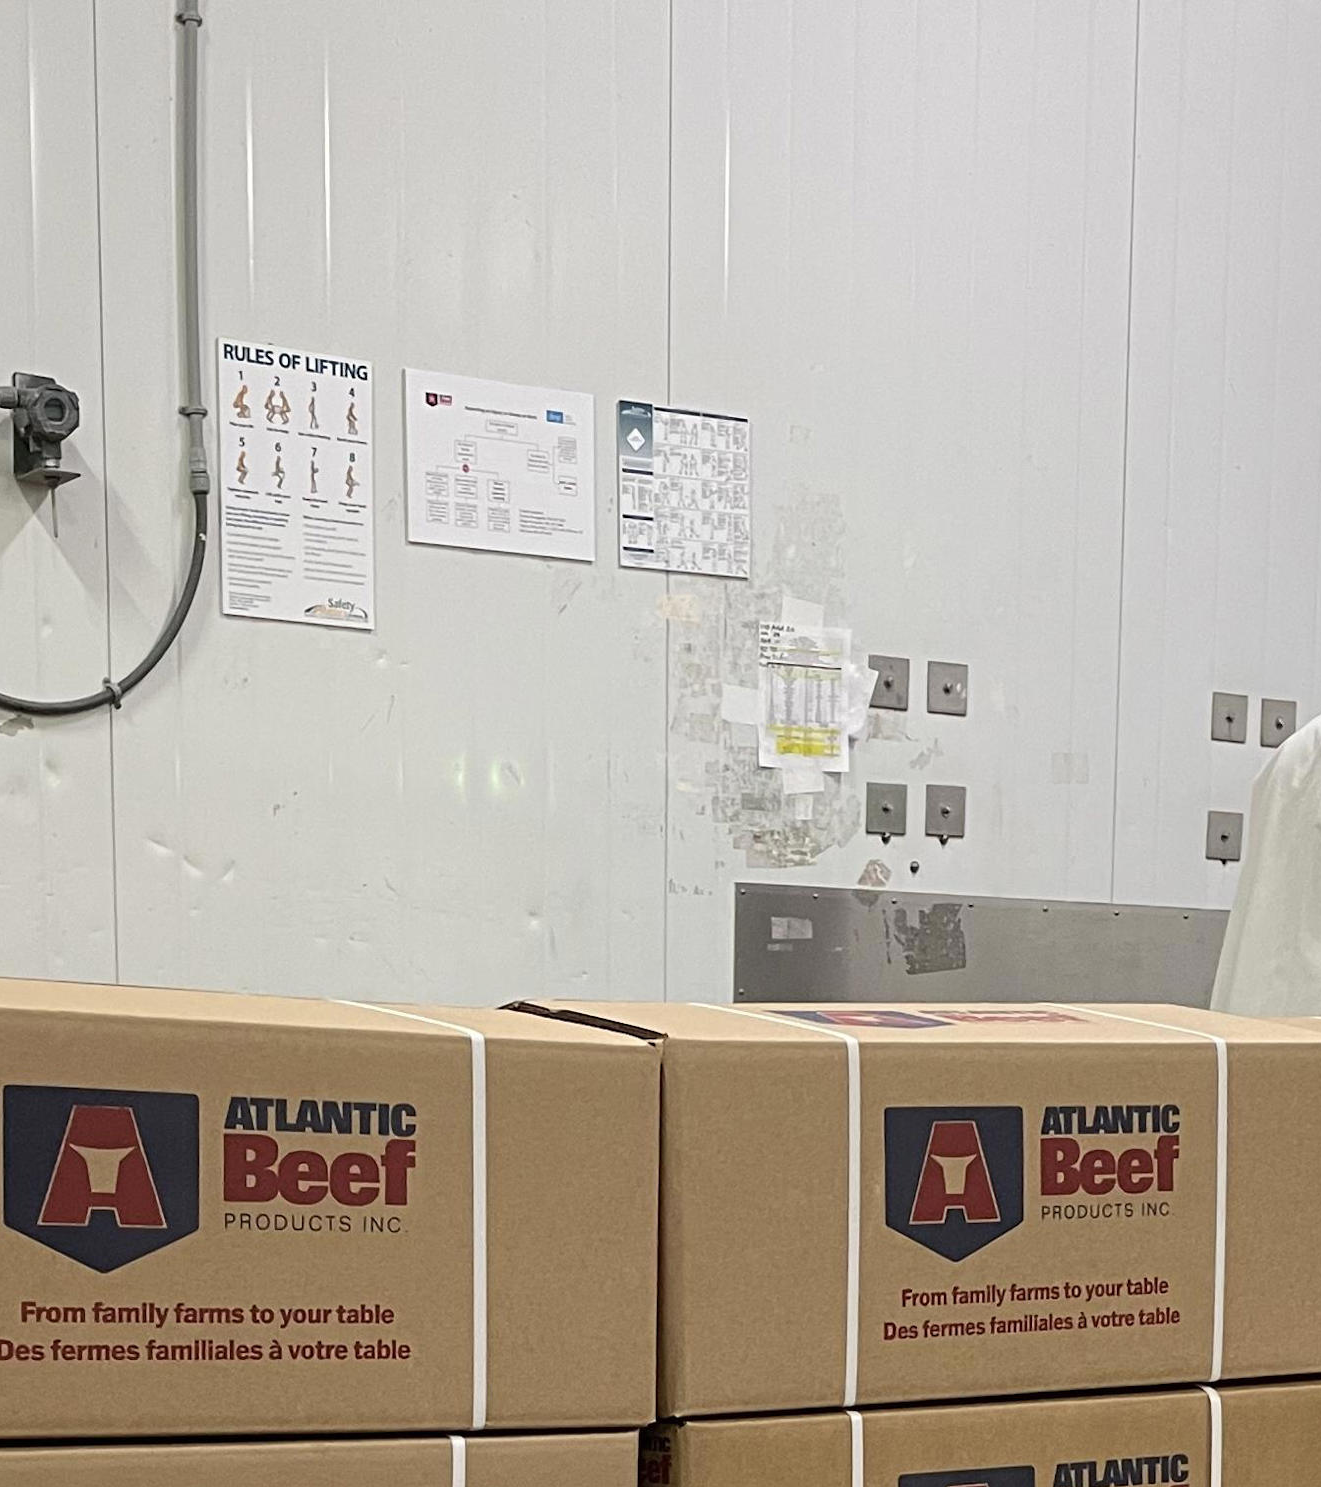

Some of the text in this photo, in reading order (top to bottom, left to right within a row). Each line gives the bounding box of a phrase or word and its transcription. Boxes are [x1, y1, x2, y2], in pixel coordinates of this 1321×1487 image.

[223, 343, 368, 381] RULES OF LIFTING
[238, 370, 355, 398] 1 2 3 4
[239, 436, 356, 463] 5 6 7 8
[327, 598, 356, 612] Safety
[224, 1097, 416, 1138] ATLANTIC
[1040, 1104, 1180, 1136] ATLANTIC
[224, 1133, 416, 1206] Beef
[1040, 1134, 1181, 1197] Beef
[225, 1212, 352, 1233] PRODUCTS
[1042, 1202, 1135, 1221] PRODUCTS
[21, 1301, 394, 1328] From family farms to your table
[50, 1339, 140, 1360] fermes
[145, 1340, 263, 1360] familiales
[269, 1340, 282, 1360] à
[288, 1341, 348, 1360] votre
[354, 1339, 411, 1359] table
